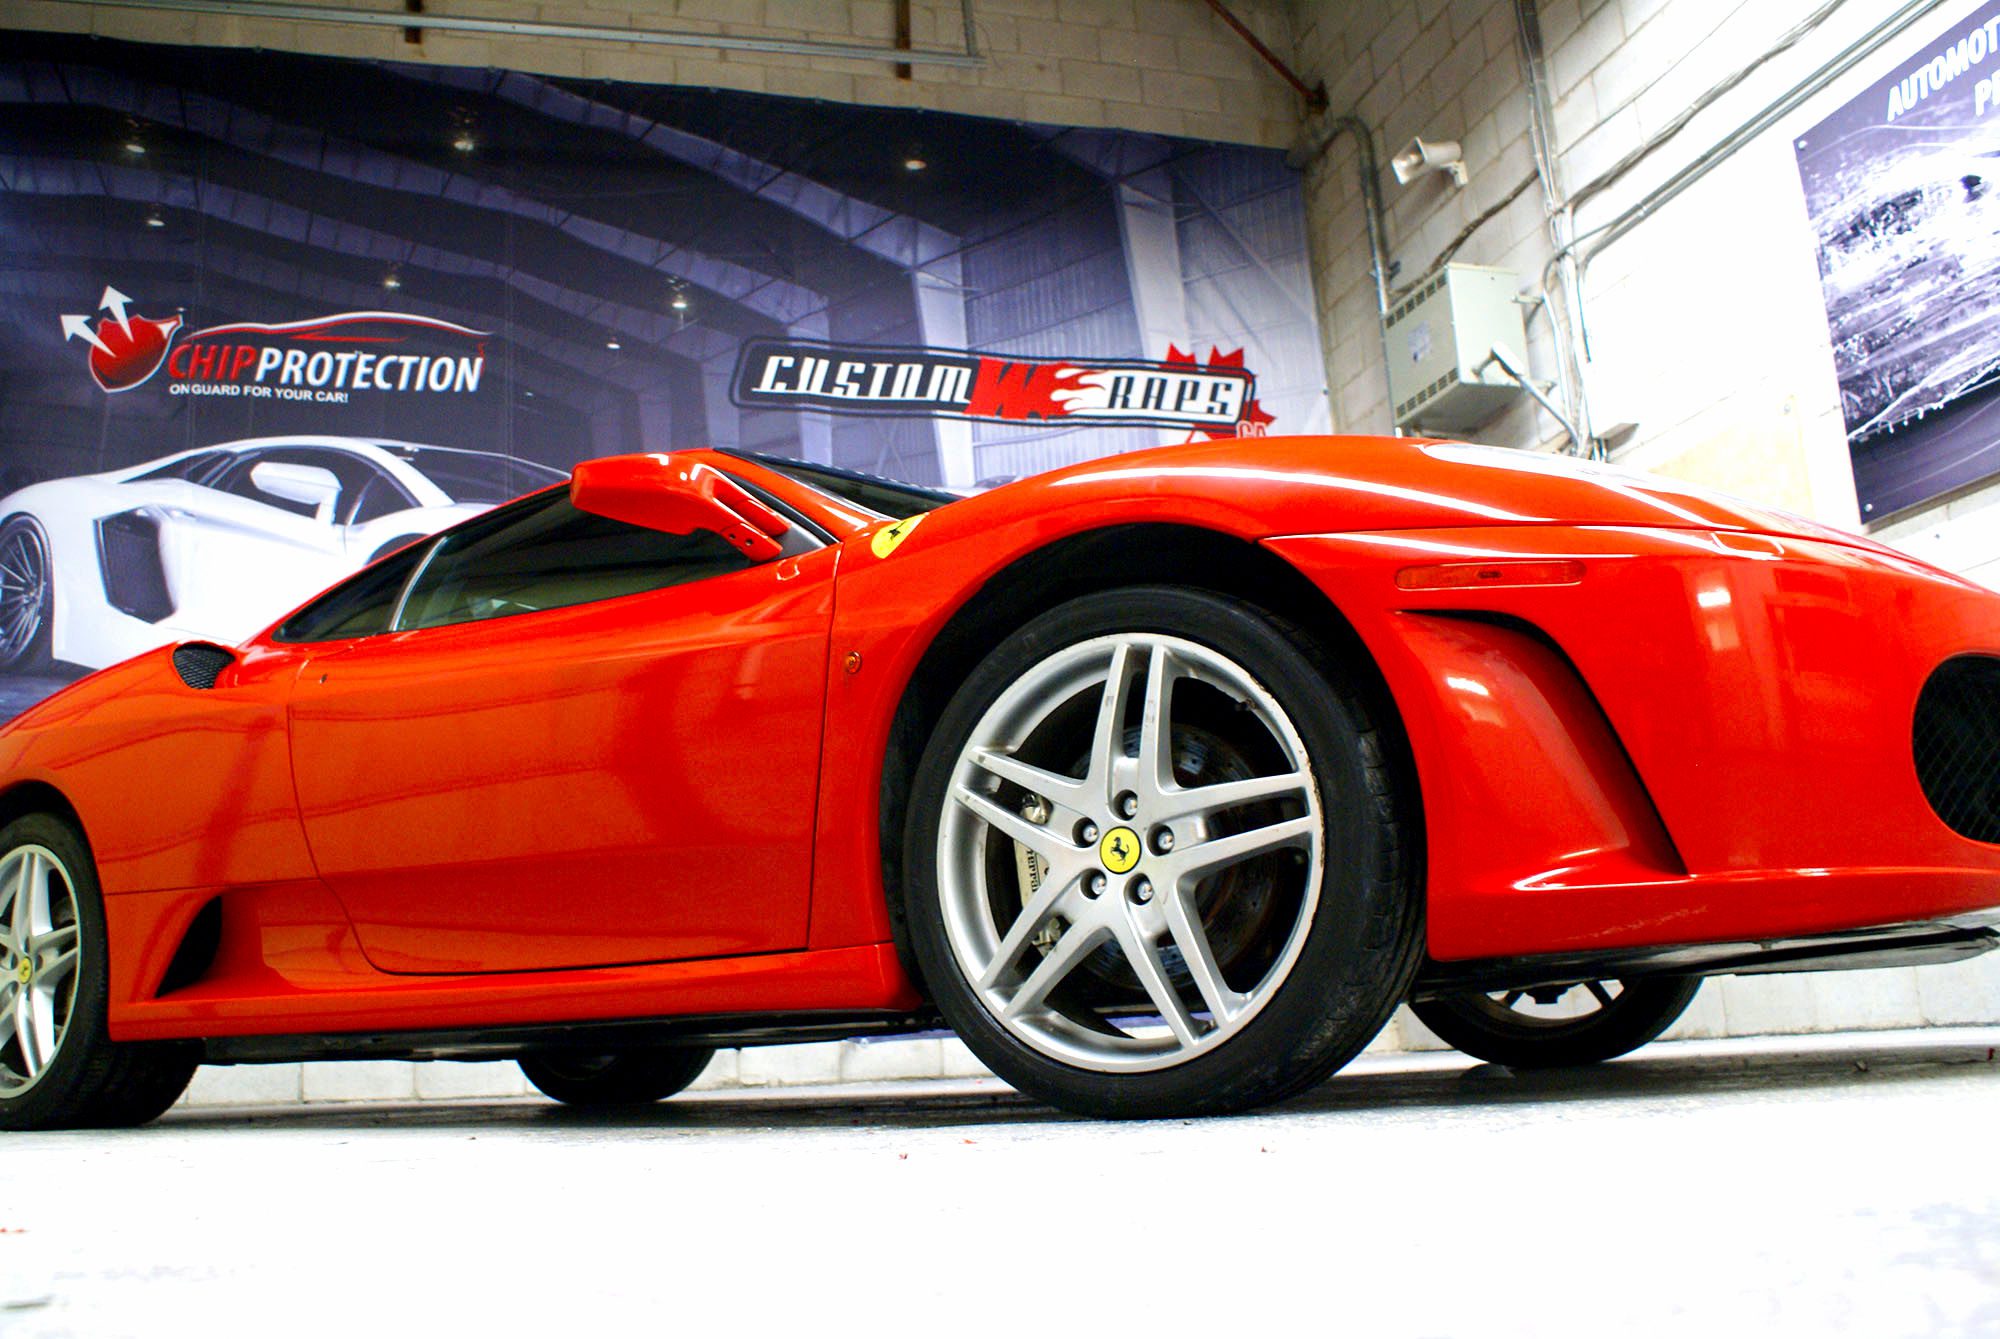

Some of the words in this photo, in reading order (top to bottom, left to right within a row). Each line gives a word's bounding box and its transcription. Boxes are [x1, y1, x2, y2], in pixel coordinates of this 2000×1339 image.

[169, 384, 190, 395] ON
[191, 384, 240, 396] GUARD
[243, 386, 272, 397] FOR
[275, 388, 313, 401] YOUR
[315, 390, 349, 403] CAR!
